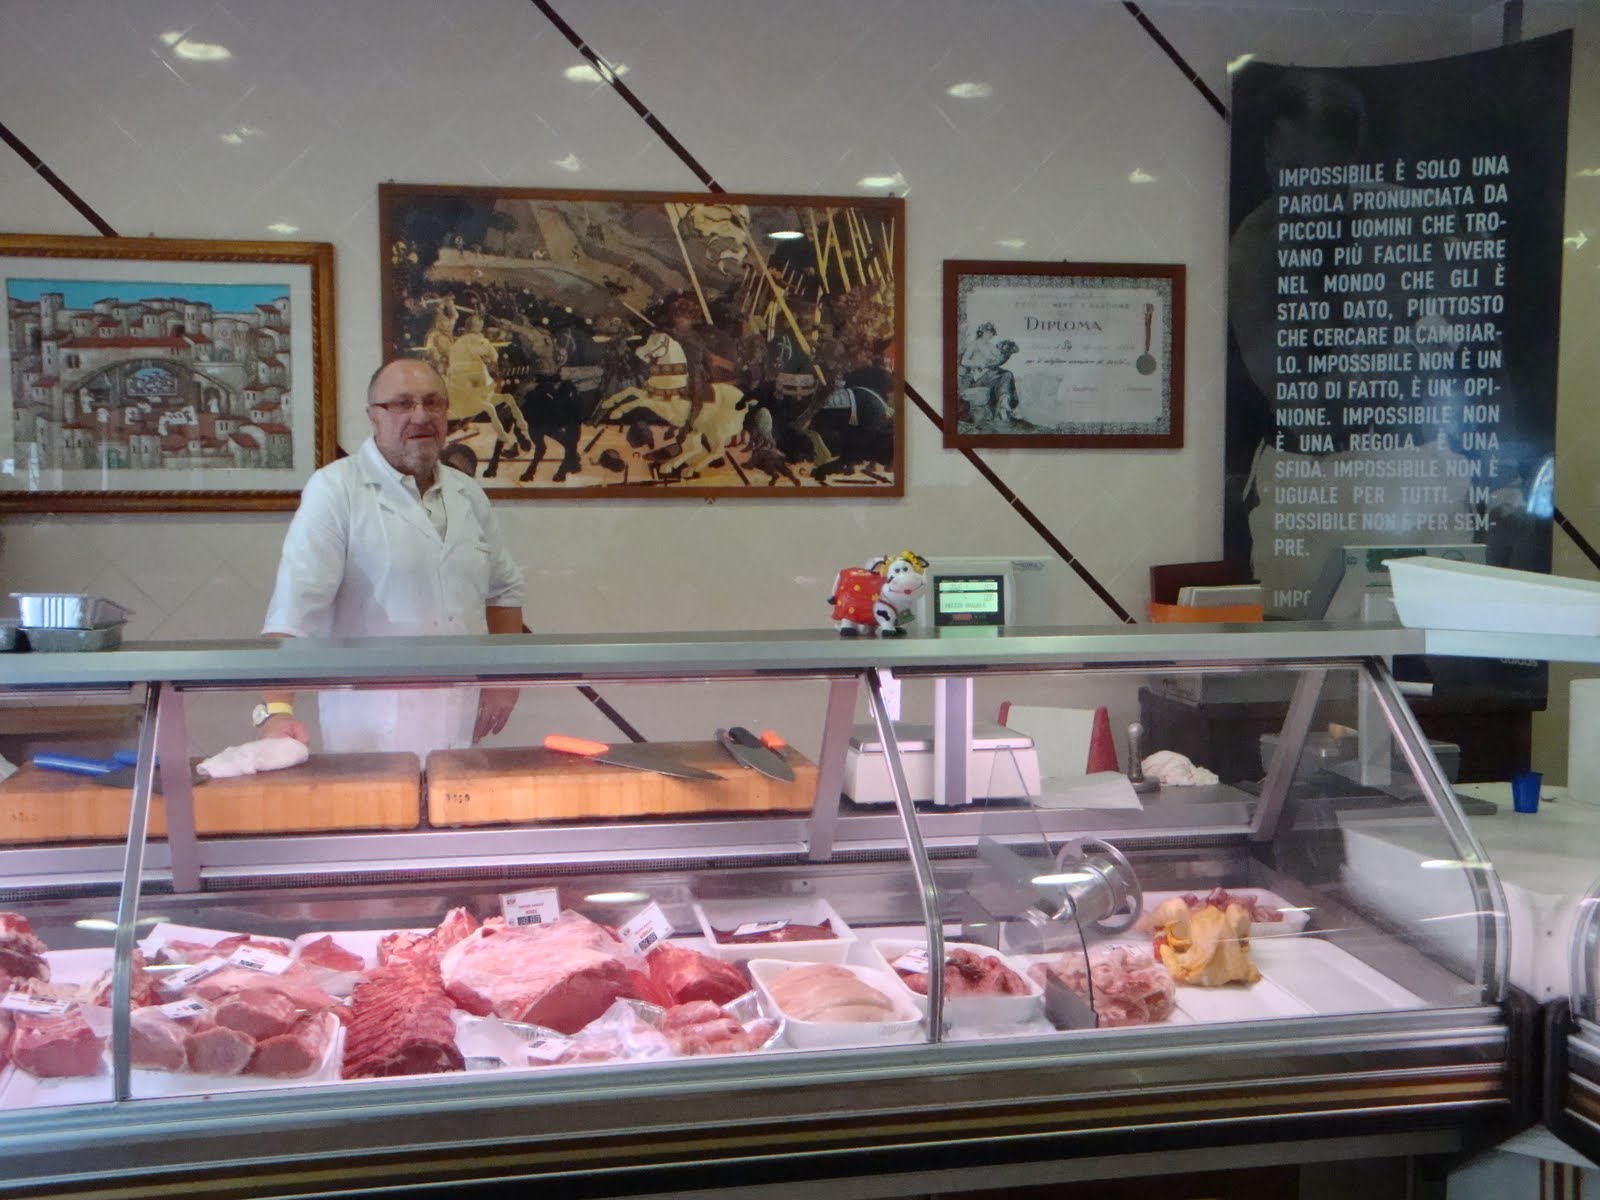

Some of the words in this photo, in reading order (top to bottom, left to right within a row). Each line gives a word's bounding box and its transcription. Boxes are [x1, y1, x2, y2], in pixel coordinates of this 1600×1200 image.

[1279, 163, 1384, 187] IMPOSSIBILE
[1395, 158, 1405, 181] È
[1416, 158, 1460, 180] SOLO
[1472, 155, 1509, 176] UNA
[1279, 193, 1344, 214] PAROLA
[1352, 186, 1475, 210] PRONUNCIATA
[1484, 183, 1508, 204] DA
[1279, 220, 1342, 241] PICCOLI
[1351, 217, 1412, 238] UOMINI
[1422, 214, 1455, 235] CHE
[1465, 211, 1507, 233] TRO-
[1278, 248, 1323, 268] VANO
[1334, 242, 1363, 266] PIÙ
[1374, 243, 1432, 264] FACILE
[1444, 239, 1506, 261] VIVERE
[1278, 275, 1308, 294] NEL
[1324, 272, 1386, 293] MONDO
[1401, 270, 1434, 290] CHE
[1450, 268, 1478, 288] GLI
[1495, 262, 1505, 286] È
[1278, 301, 1330, 321] STATO
[1343, 299, 1393, 321] DATO,
[1408, 294, 1504, 317] PIUTTOSTO
[1277, 329, 1308, 347] CHE
[1313, 326, 1388, 346] CERCARE
[1394, 326, 1410, 344] DI
[1416, 322, 1502, 343] CAMBIAR-
[1277, 355, 1301, 374] LO.
[1308, 352, 1412, 373] IMPOSSIBILE
[1419, 351, 1454, 371] NON
[1462, 346, 1471, 369] È
[1478, 350, 1502, 369] UN
[1276, 381, 1318, 400] DATO
[1325, 381, 1341, 399] DI
[1412, 375, 1421, 398] È
[1464, 377, 1502, 397] OPI-
[1276, 407, 1331, 427] NIONE.
[1343, 405, 1452, 426] IMPOSSIBILE
[1463, 404, 1500, 424] NON
[1275, 430, 1285, 452] È
[1300, 434, 1334, 452] UNA
[1462, 431, 1499, 450] UNA
[1275, 460, 1327, 478] SFIDA.
[1334, 459, 1440, 478] IMPOSSIBILE
[1445, 458, 1482, 478] NON
[1489, 454, 1499, 477] È
[1275, 487, 1338, 504] UGUALE
[1353, 486, 1385, 504] PER
[1468, 486, 1498, 504] IM-
[1275, 512, 1357, 531] POSSIBILE
[1362, 512, 1396, 530] NON
[1416, 512, 1448, 531] PER
[1454, 513, 1497, 531] SEM-
[1275, 539, 1311, 557] PRE.
